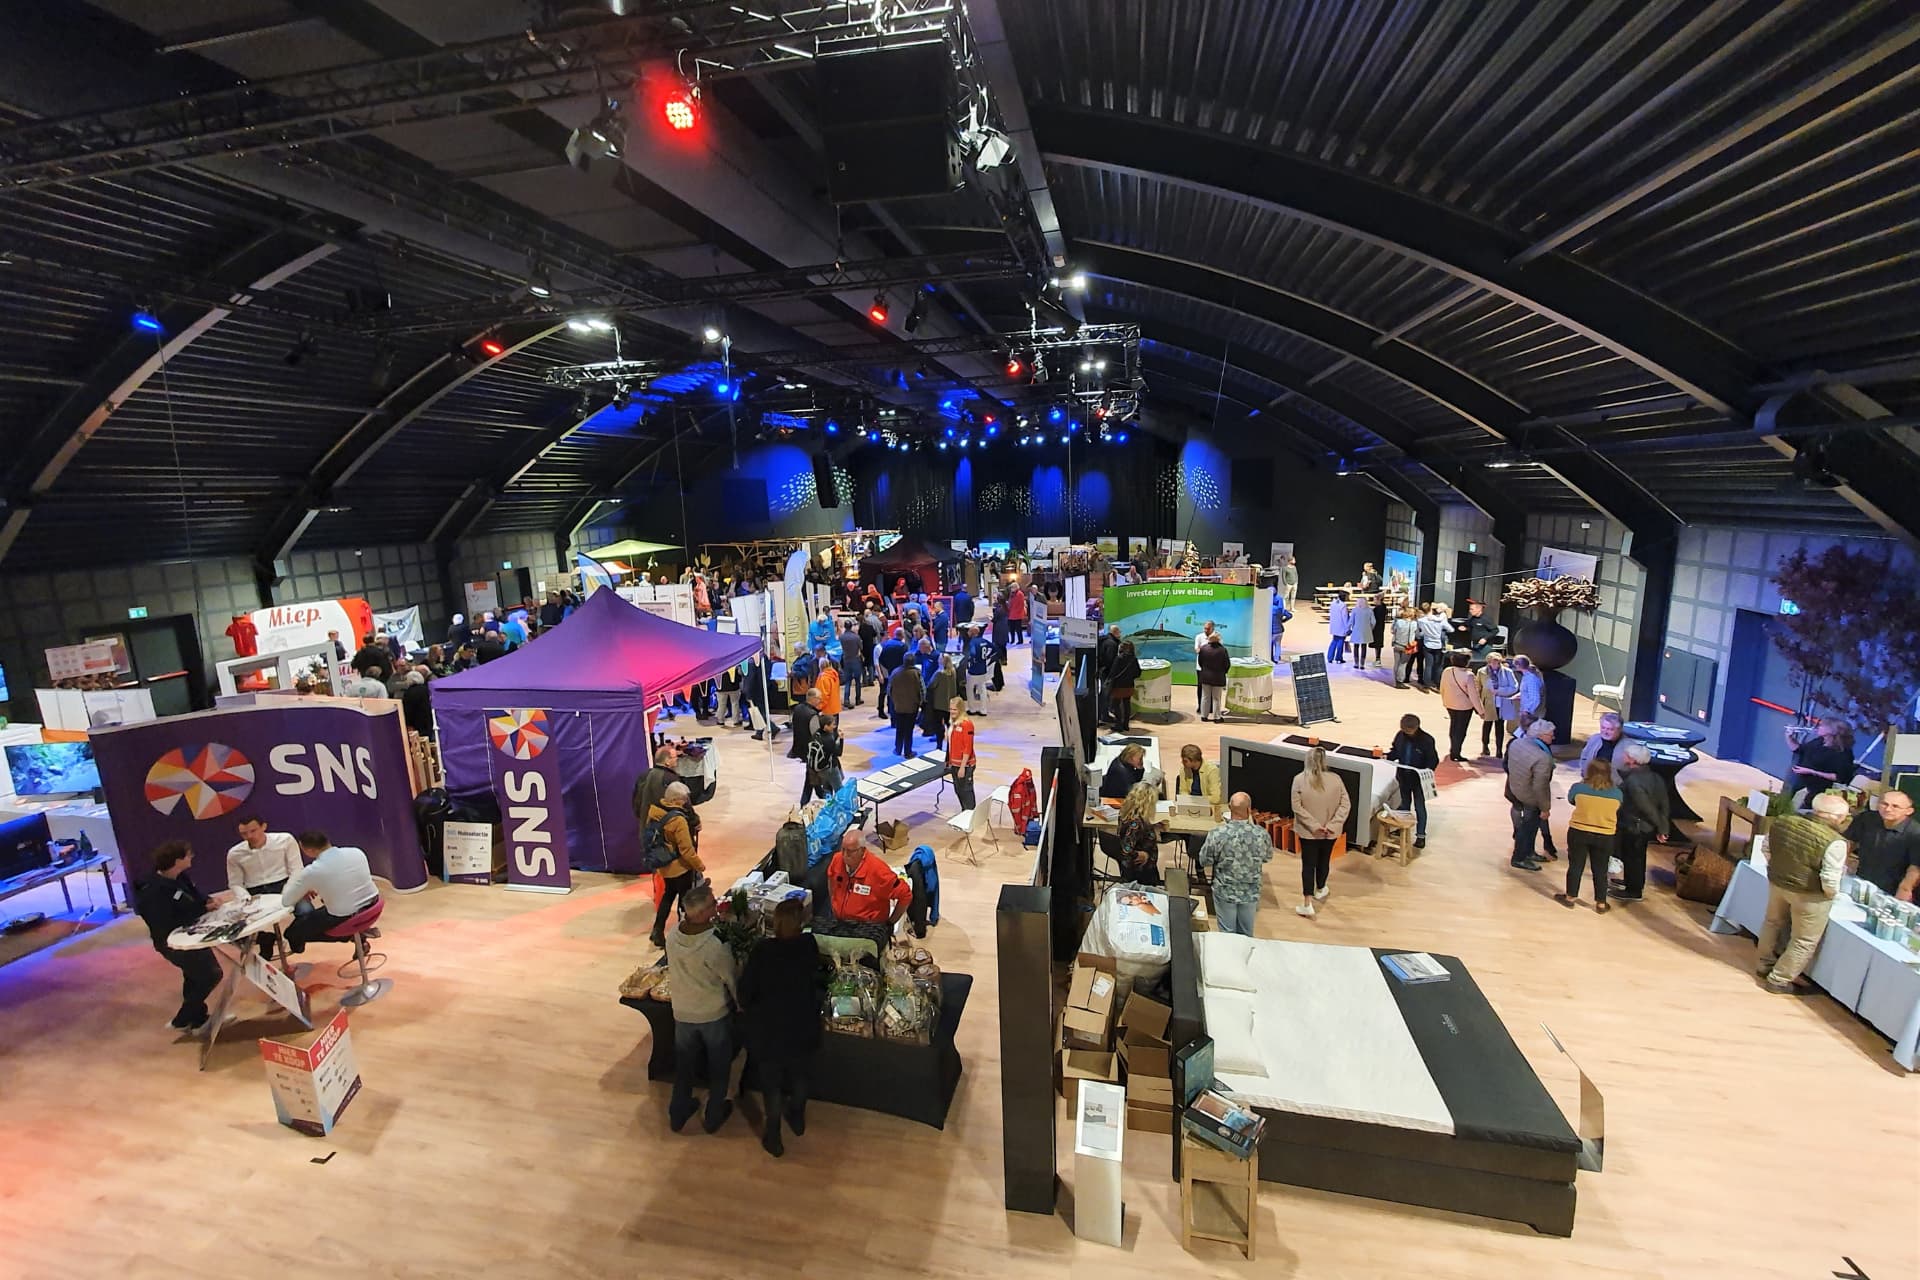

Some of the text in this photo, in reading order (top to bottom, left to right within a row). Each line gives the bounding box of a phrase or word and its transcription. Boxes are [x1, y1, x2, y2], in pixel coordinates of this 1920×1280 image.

[1126, 589, 1161, 598] Investeer
[1163, 588, 1171, 596] in
[1187, 587, 1213, 596] eiland
[269, 743, 377, 800] SNS
[504, 770, 556, 877] SNS
